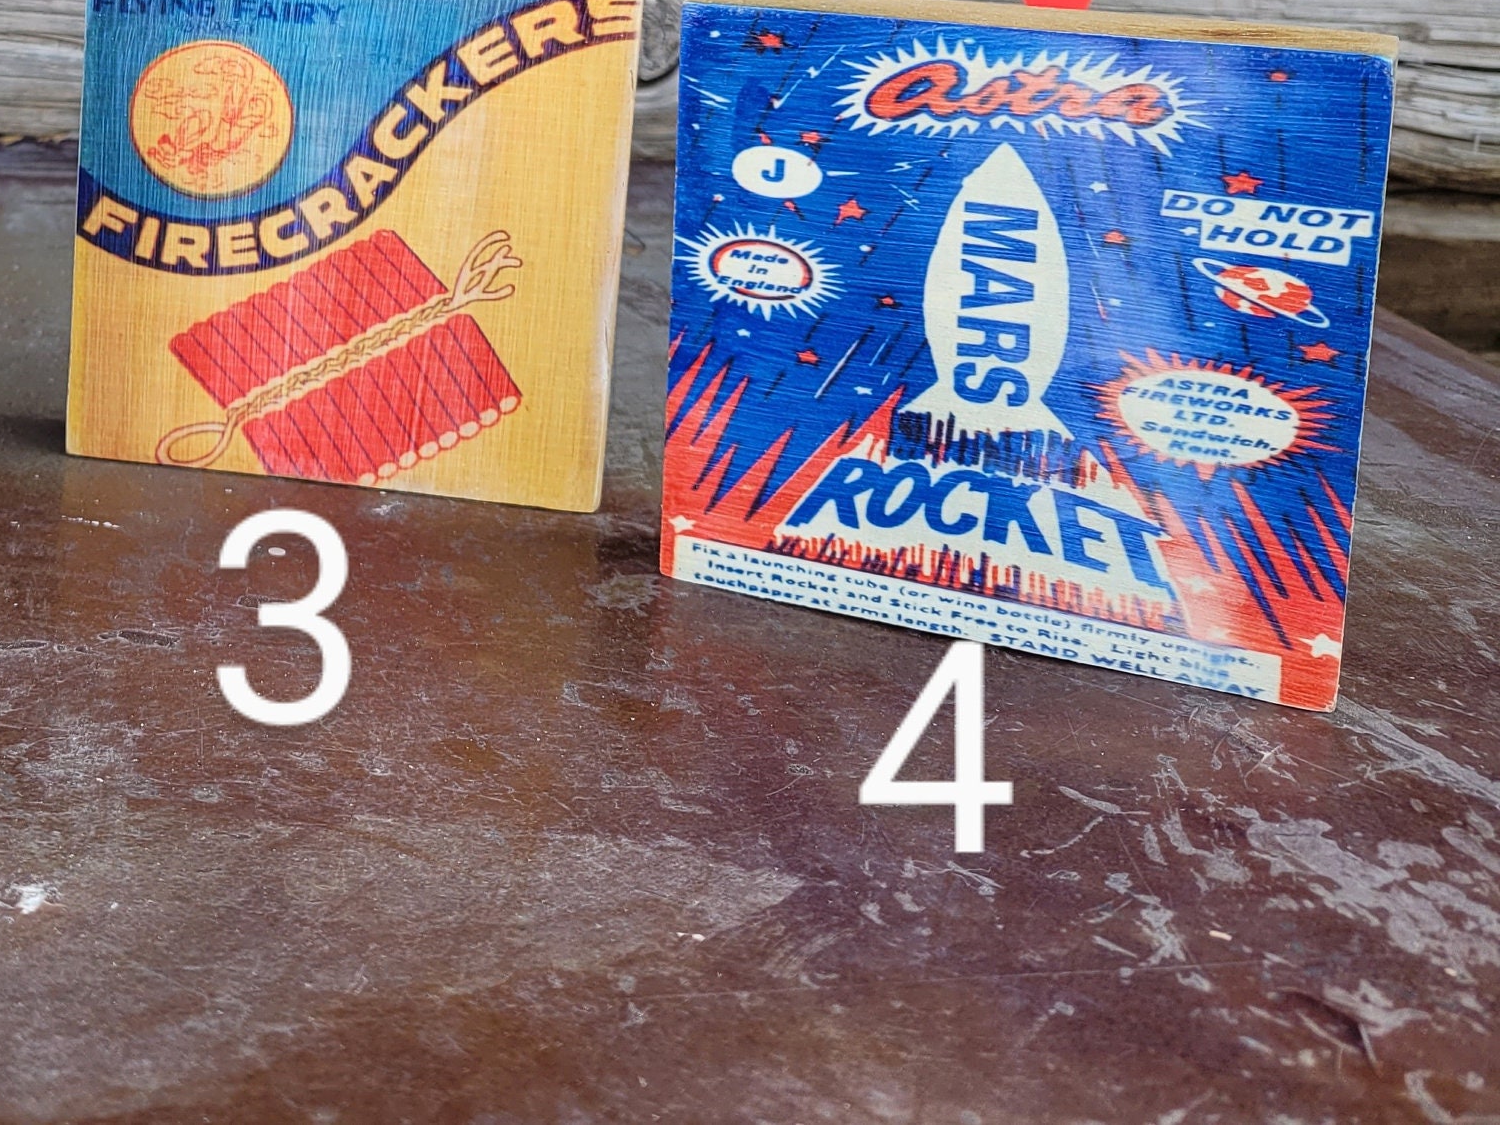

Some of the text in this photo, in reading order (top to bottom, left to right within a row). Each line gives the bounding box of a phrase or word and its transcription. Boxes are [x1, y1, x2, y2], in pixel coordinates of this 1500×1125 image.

[760, 158, 786, 183] J
[1163, 193, 1371, 230] DO NOT
[729, 249, 789, 265] Made
[1205, 224, 1345, 254] HOLD
[717, 274, 802, 295] England
[953, 201, 1040, 409] MARS
[1121, 386, 1293, 422] FIREWORKS
[1156, 377, 1250, 400] ASTRA
[1173, 409, 1235, 428] LTD.
[787, 455, 1171, 601] ROCKET
[690, 542, 721, 558] Fix
[726, 551, 738, 561] a
[742, 553, 837, 582] launching
[844, 575, 890, 593] tube
[898, 585, 930, 600] (or
[937, 594, 988, 613] wine
[1080, 623, 1150, 647] firmly
[707, 558, 765, 581] Insert
[770, 572, 840, 596] Rocket
[845, 588, 882, 605] and
[888, 598, 943, 618] Stick
[950, 610, 998, 628] Free
[1006, 621, 1029, 635] to
[1109, 642, 1172, 666] Light
[693, 571, 805, 602] touchpaper
[810, 594, 832, 608] at
[837, 600, 890, 620] arms
[989, 632, 1079, 659] STAND
[1090, 652, 1167, 678] WELL
[1173, 671, 1266, 698] AWAY
